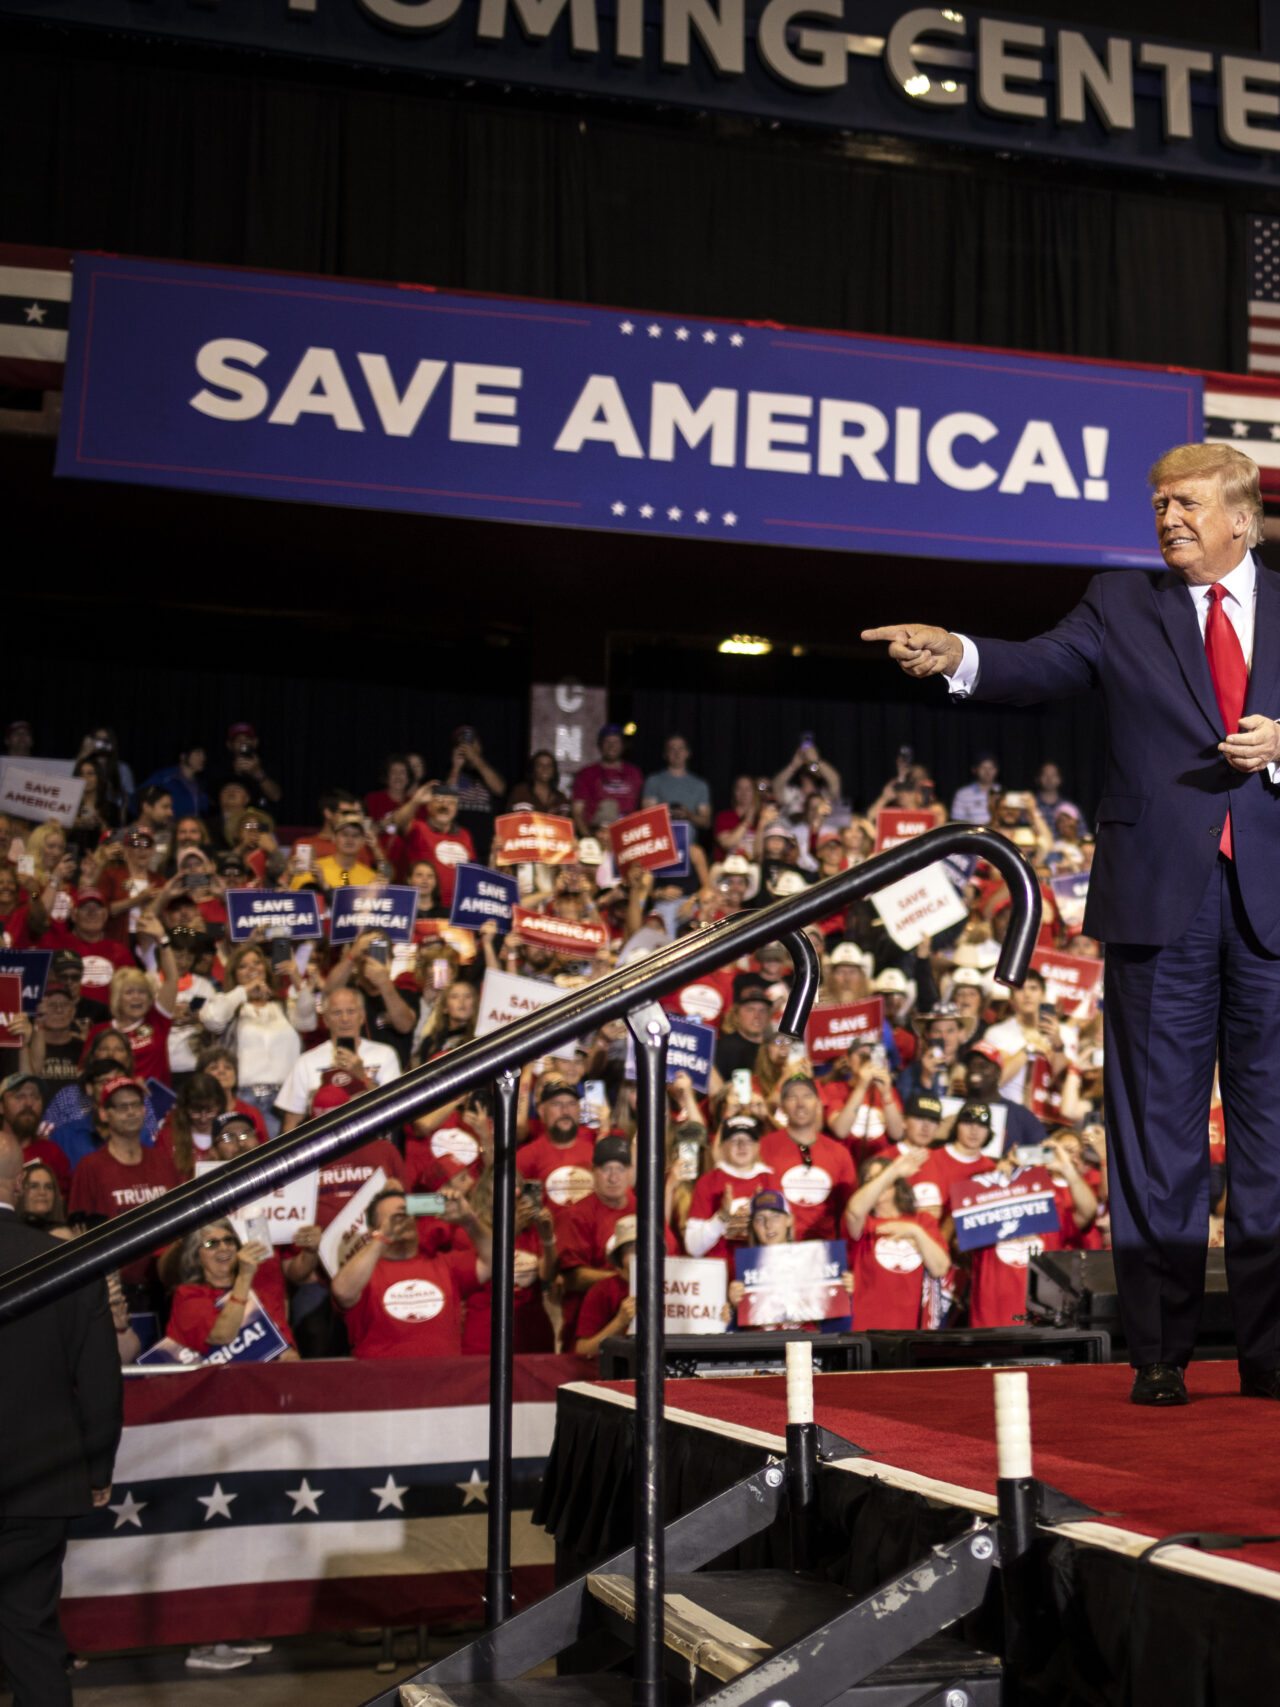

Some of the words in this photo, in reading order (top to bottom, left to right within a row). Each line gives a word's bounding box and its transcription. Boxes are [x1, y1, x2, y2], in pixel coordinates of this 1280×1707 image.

[189, 337, 523, 446] SAVE
[553, 374, 1109, 501] AMERICA!
[24, 781, 61, 798] SAVE
[5, 790, 72, 815] AMERICA!
[622, 823, 651, 846] SAVE
[477, 881, 508, 902] SAVE
[252, 898, 295, 914] SAVE
[353, 898, 394, 913] SAVE
[237, 911, 314, 929] AMERICA!
[336, 913, 409, 930] AMERICA!
[521, 916, 602, 944] AMERICA!
[829, 1013, 869, 1034] SAVE
[668, 1031, 698, 1051] AVE
[666, 1049, 708, 1074] ERICA!
[664, 1304, 717, 1320] ERICA!
